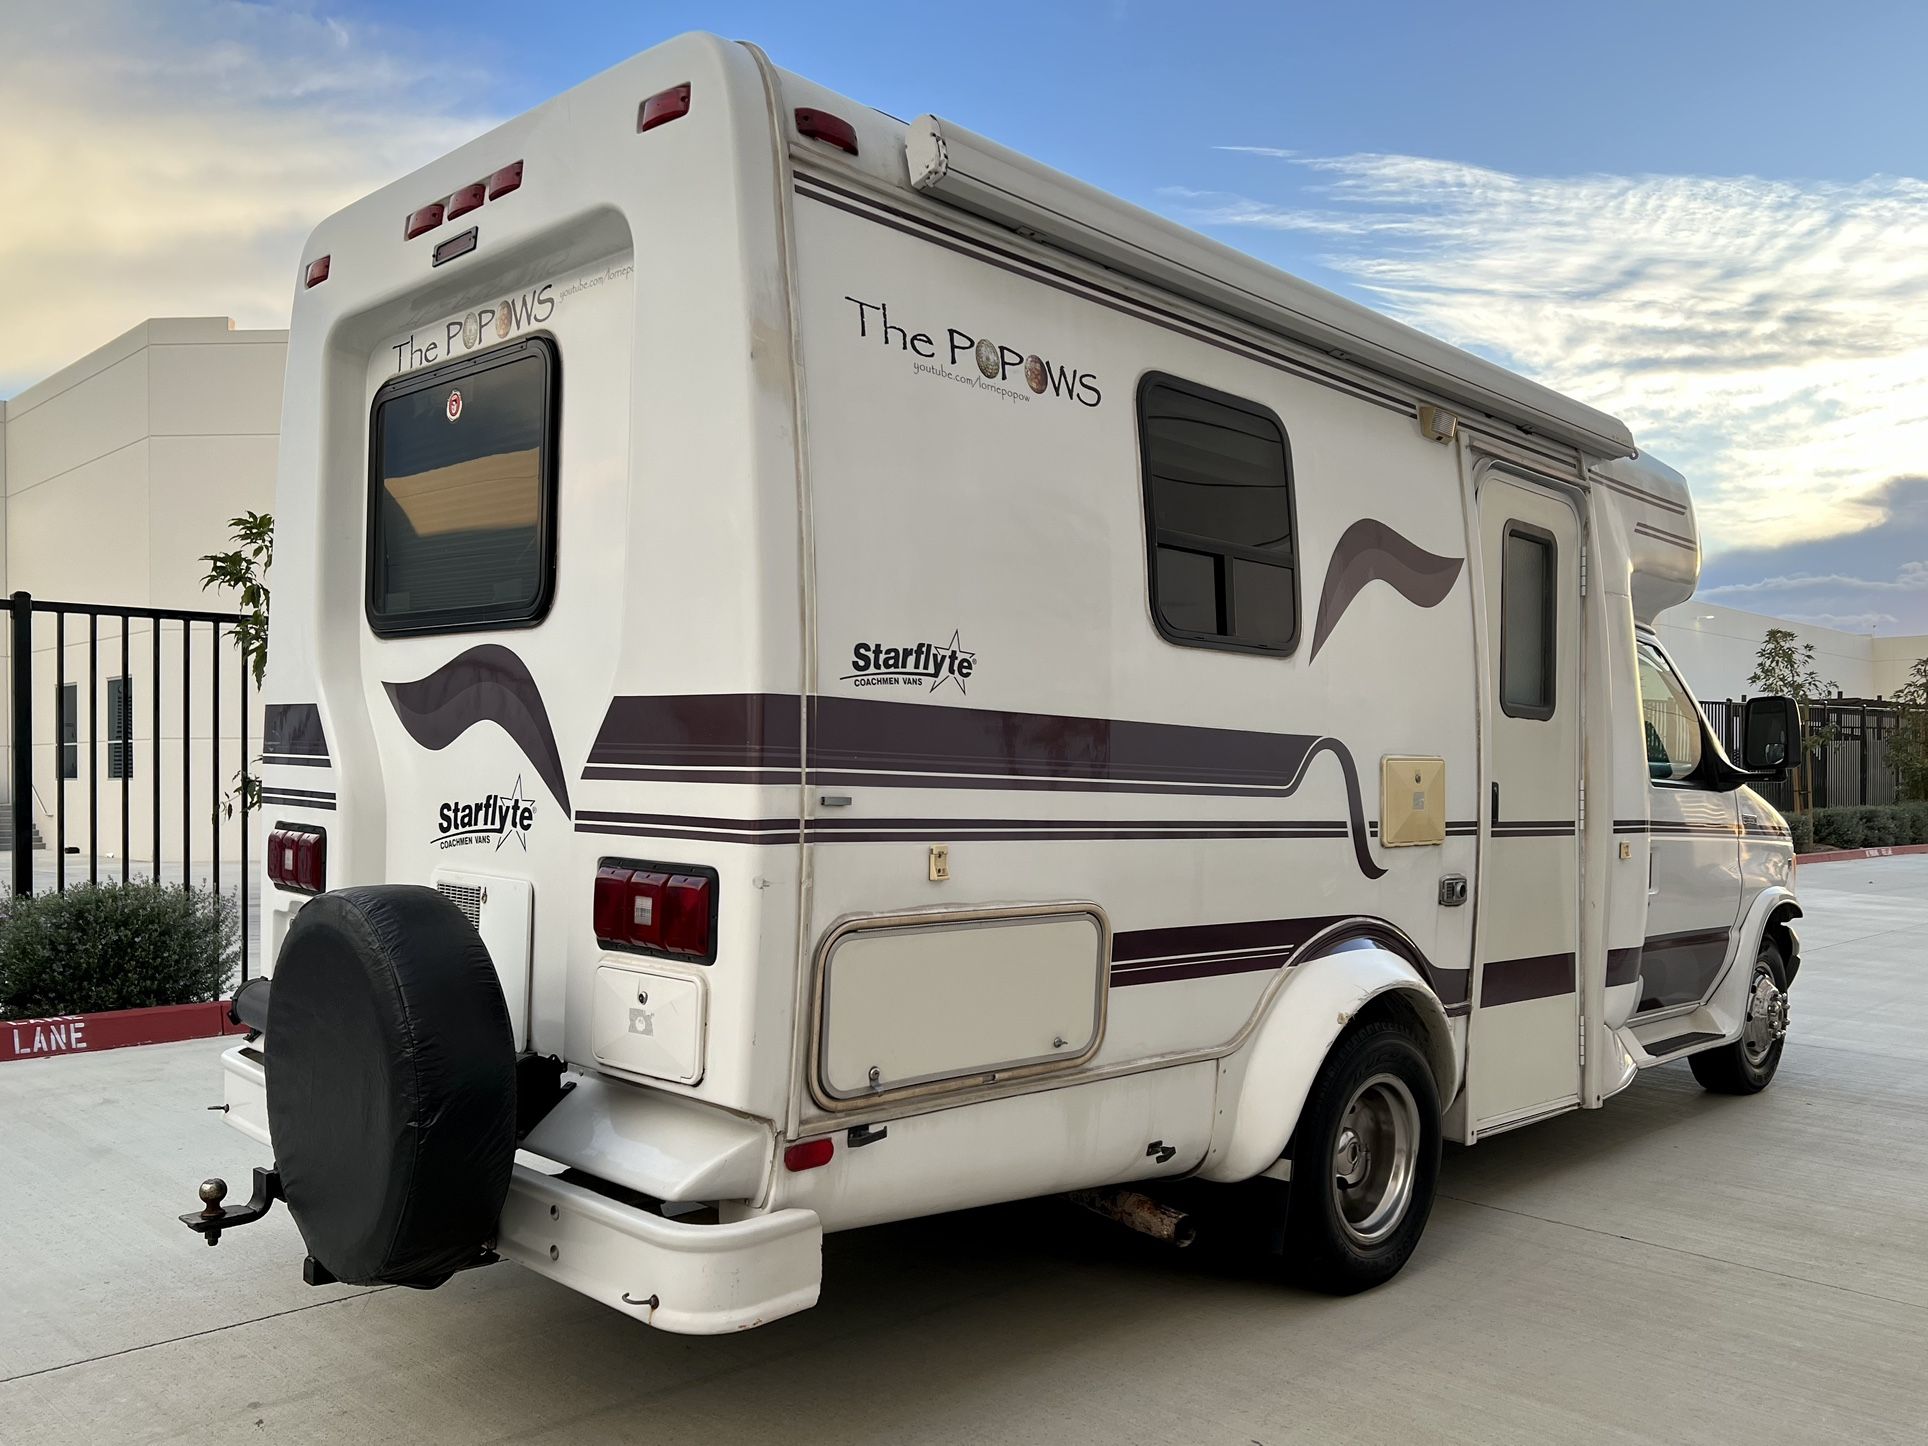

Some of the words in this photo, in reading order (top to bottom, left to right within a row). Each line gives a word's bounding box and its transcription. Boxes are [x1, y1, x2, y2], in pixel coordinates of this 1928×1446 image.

[392, 334, 438, 373] The
[446, 283, 555, 357] POPOWS
[845, 296, 935, 358] The
[947, 328, 1102, 407] POPOWS
[854, 677, 900, 687] COACHMEN
[902, 677, 923, 686] VANS
[440, 837, 473, 850] COACHMEN
[474, 835, 491, 844] VANS
[13, 1022, 87, 1055] LANE
